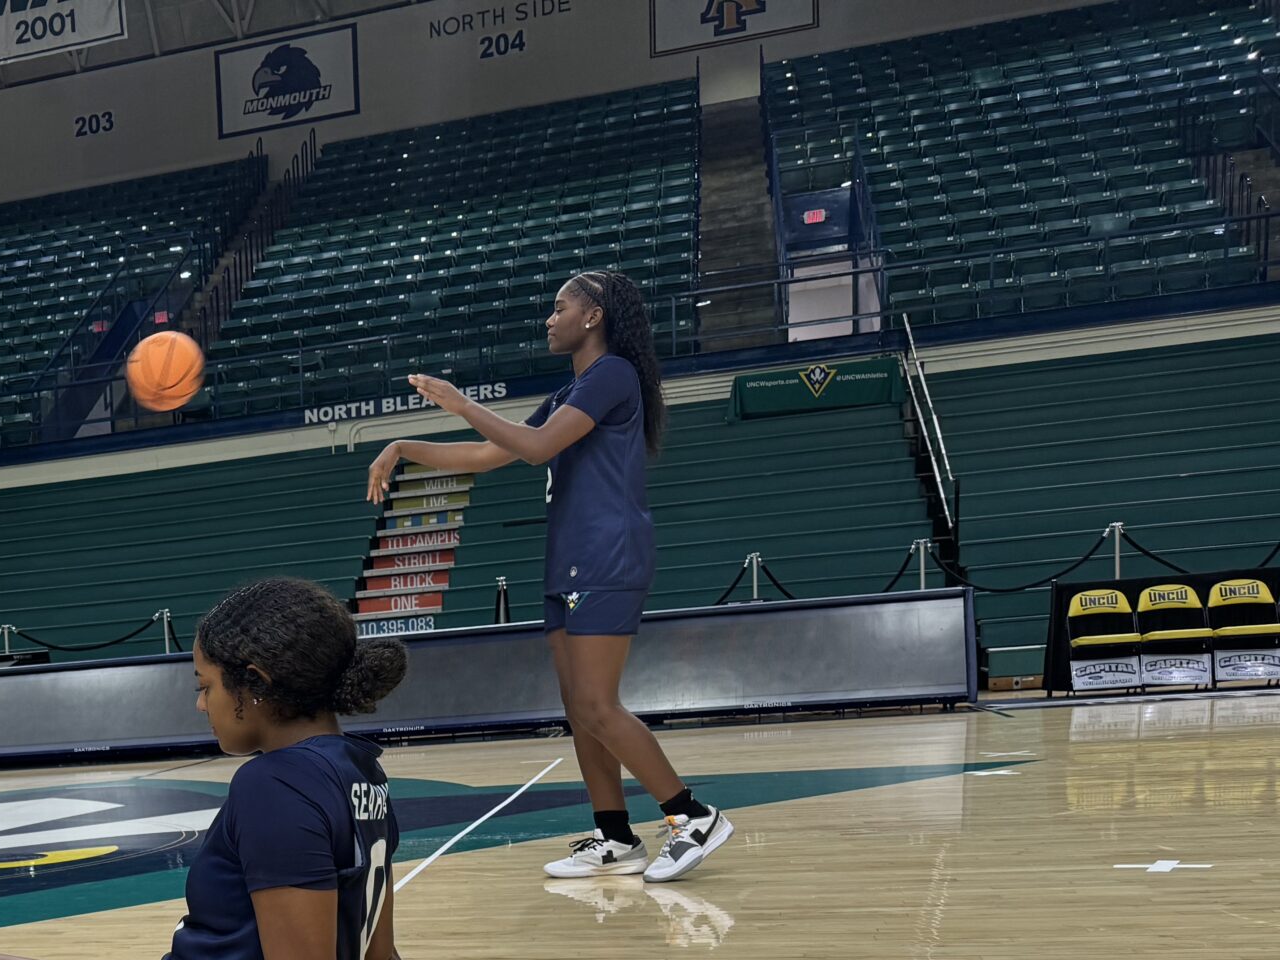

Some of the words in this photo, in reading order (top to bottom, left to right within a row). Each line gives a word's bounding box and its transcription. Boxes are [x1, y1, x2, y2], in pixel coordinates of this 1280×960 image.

[15, 8, 76, 44] 2001
[430, 7, 505, 38] NORTH
[515, 0, 571, 21] SIDE
[480, 29, 526, 59] 204
[244, 86, 331, 113] MONMOUTH
[75, 111, 114, 137] 203
[304, 400, 375, 425] NORTH
[382, 382, 507, 413] BLEAERS
[424, 477, 457, 490] WITH
[423, 495, 448, 508] LIVE
[386, 535, 404, 550] TO
[407, 530, 460, 548] CAMPUS
[391, 573, 435, 590] BLOCK
[1149, 589, 1188, 603] UNCW
[1220, 583, 1260, 599] UNCW
[391, 595, 420, 611] ONE
[1080, 594, 1118, 608] UNCW
[1075, 662, 1136, 678] CAPITAL
[1145, 658, 1207, 673] CAPITAL
